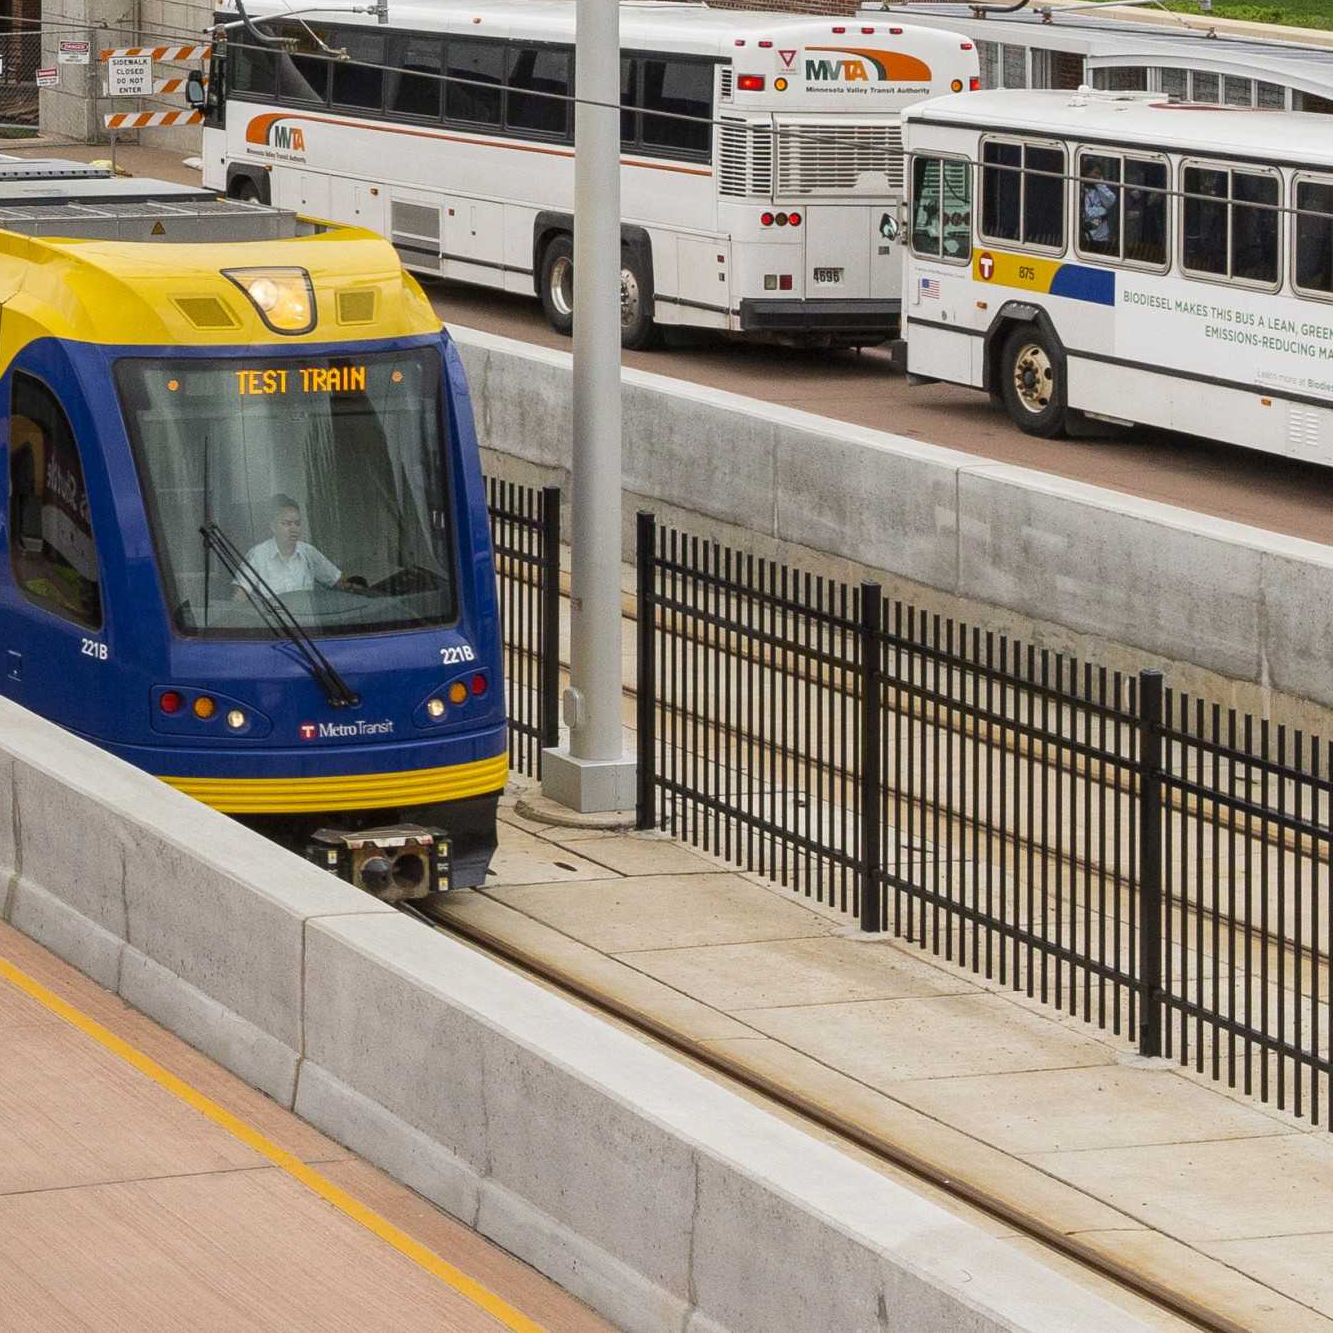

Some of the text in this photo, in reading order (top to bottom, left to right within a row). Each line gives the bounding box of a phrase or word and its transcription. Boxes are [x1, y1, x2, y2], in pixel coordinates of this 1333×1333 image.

[805, 59, 869, 81] MVTA
[846, 86, 868, 94] Valley
[870, 86, 895, 94] Transit
[274, 125, 306, 152] MVTA
[1018, 265, 1035, 281] 875
[1123, 290, 1173, 311] BIODIESEL
[1174, 299, 1209, 318] MAKES
[1210, 306, 1232, 322] THIS
[1235, 311, 1255, 327] BUS
[1257, 316, 1265, 328] A
[1268, 317, 1299, 336] LEAN,
[1204, 325, 1316, 358] EMISSIONS-REDUCING
[235, 366, 366, 395] TEST TRAIN
[81, 638, 108, 660] 221B
[440, 645, 475, 665] 221B
